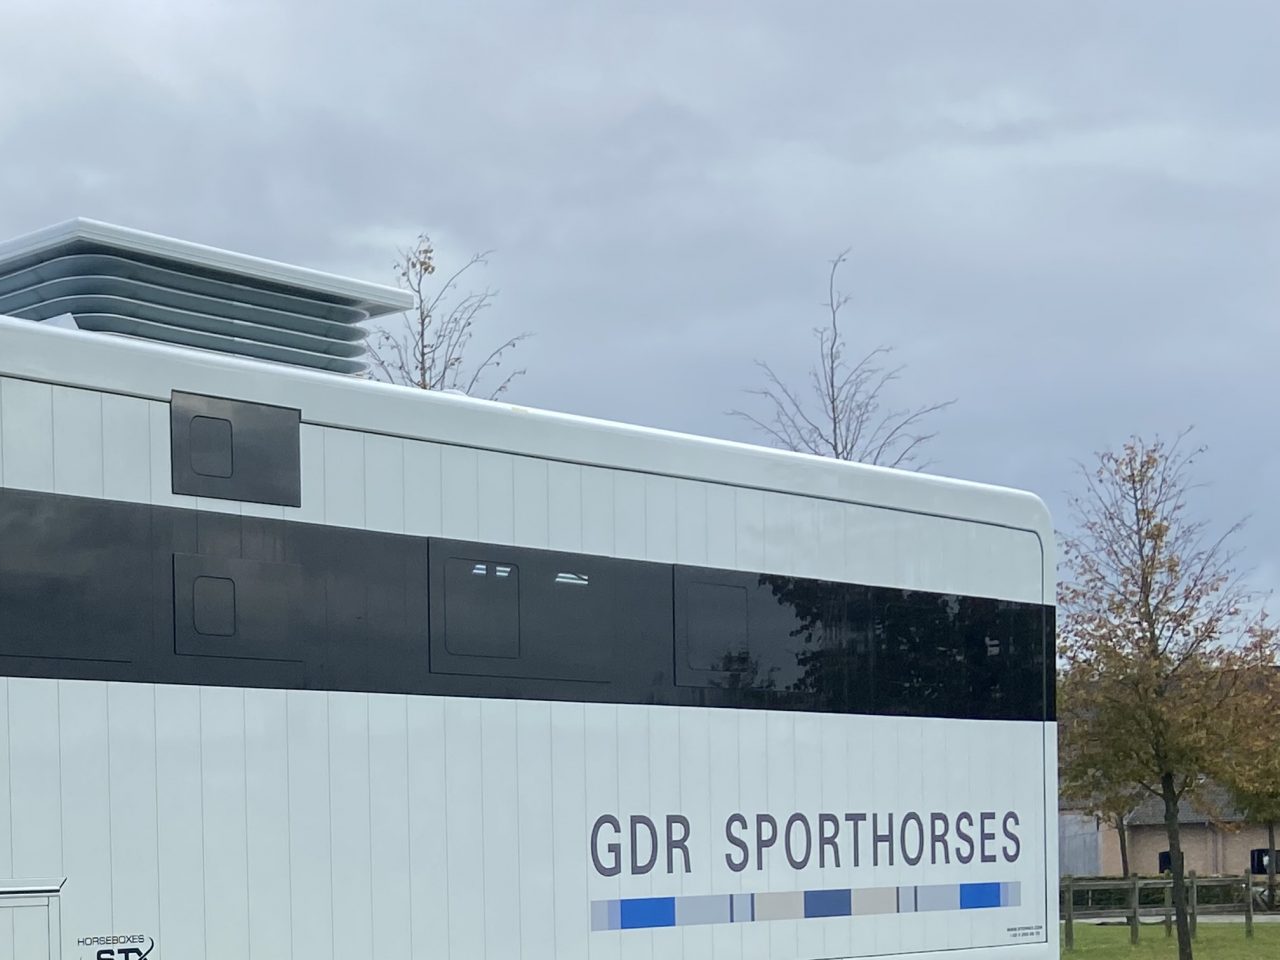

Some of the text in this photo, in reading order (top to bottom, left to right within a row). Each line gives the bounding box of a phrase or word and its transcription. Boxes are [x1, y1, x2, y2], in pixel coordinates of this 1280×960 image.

[590, 811, 1021, 877] GDR SPORTHORSES
[77, 934, 145, 946] HORSEBOXES
